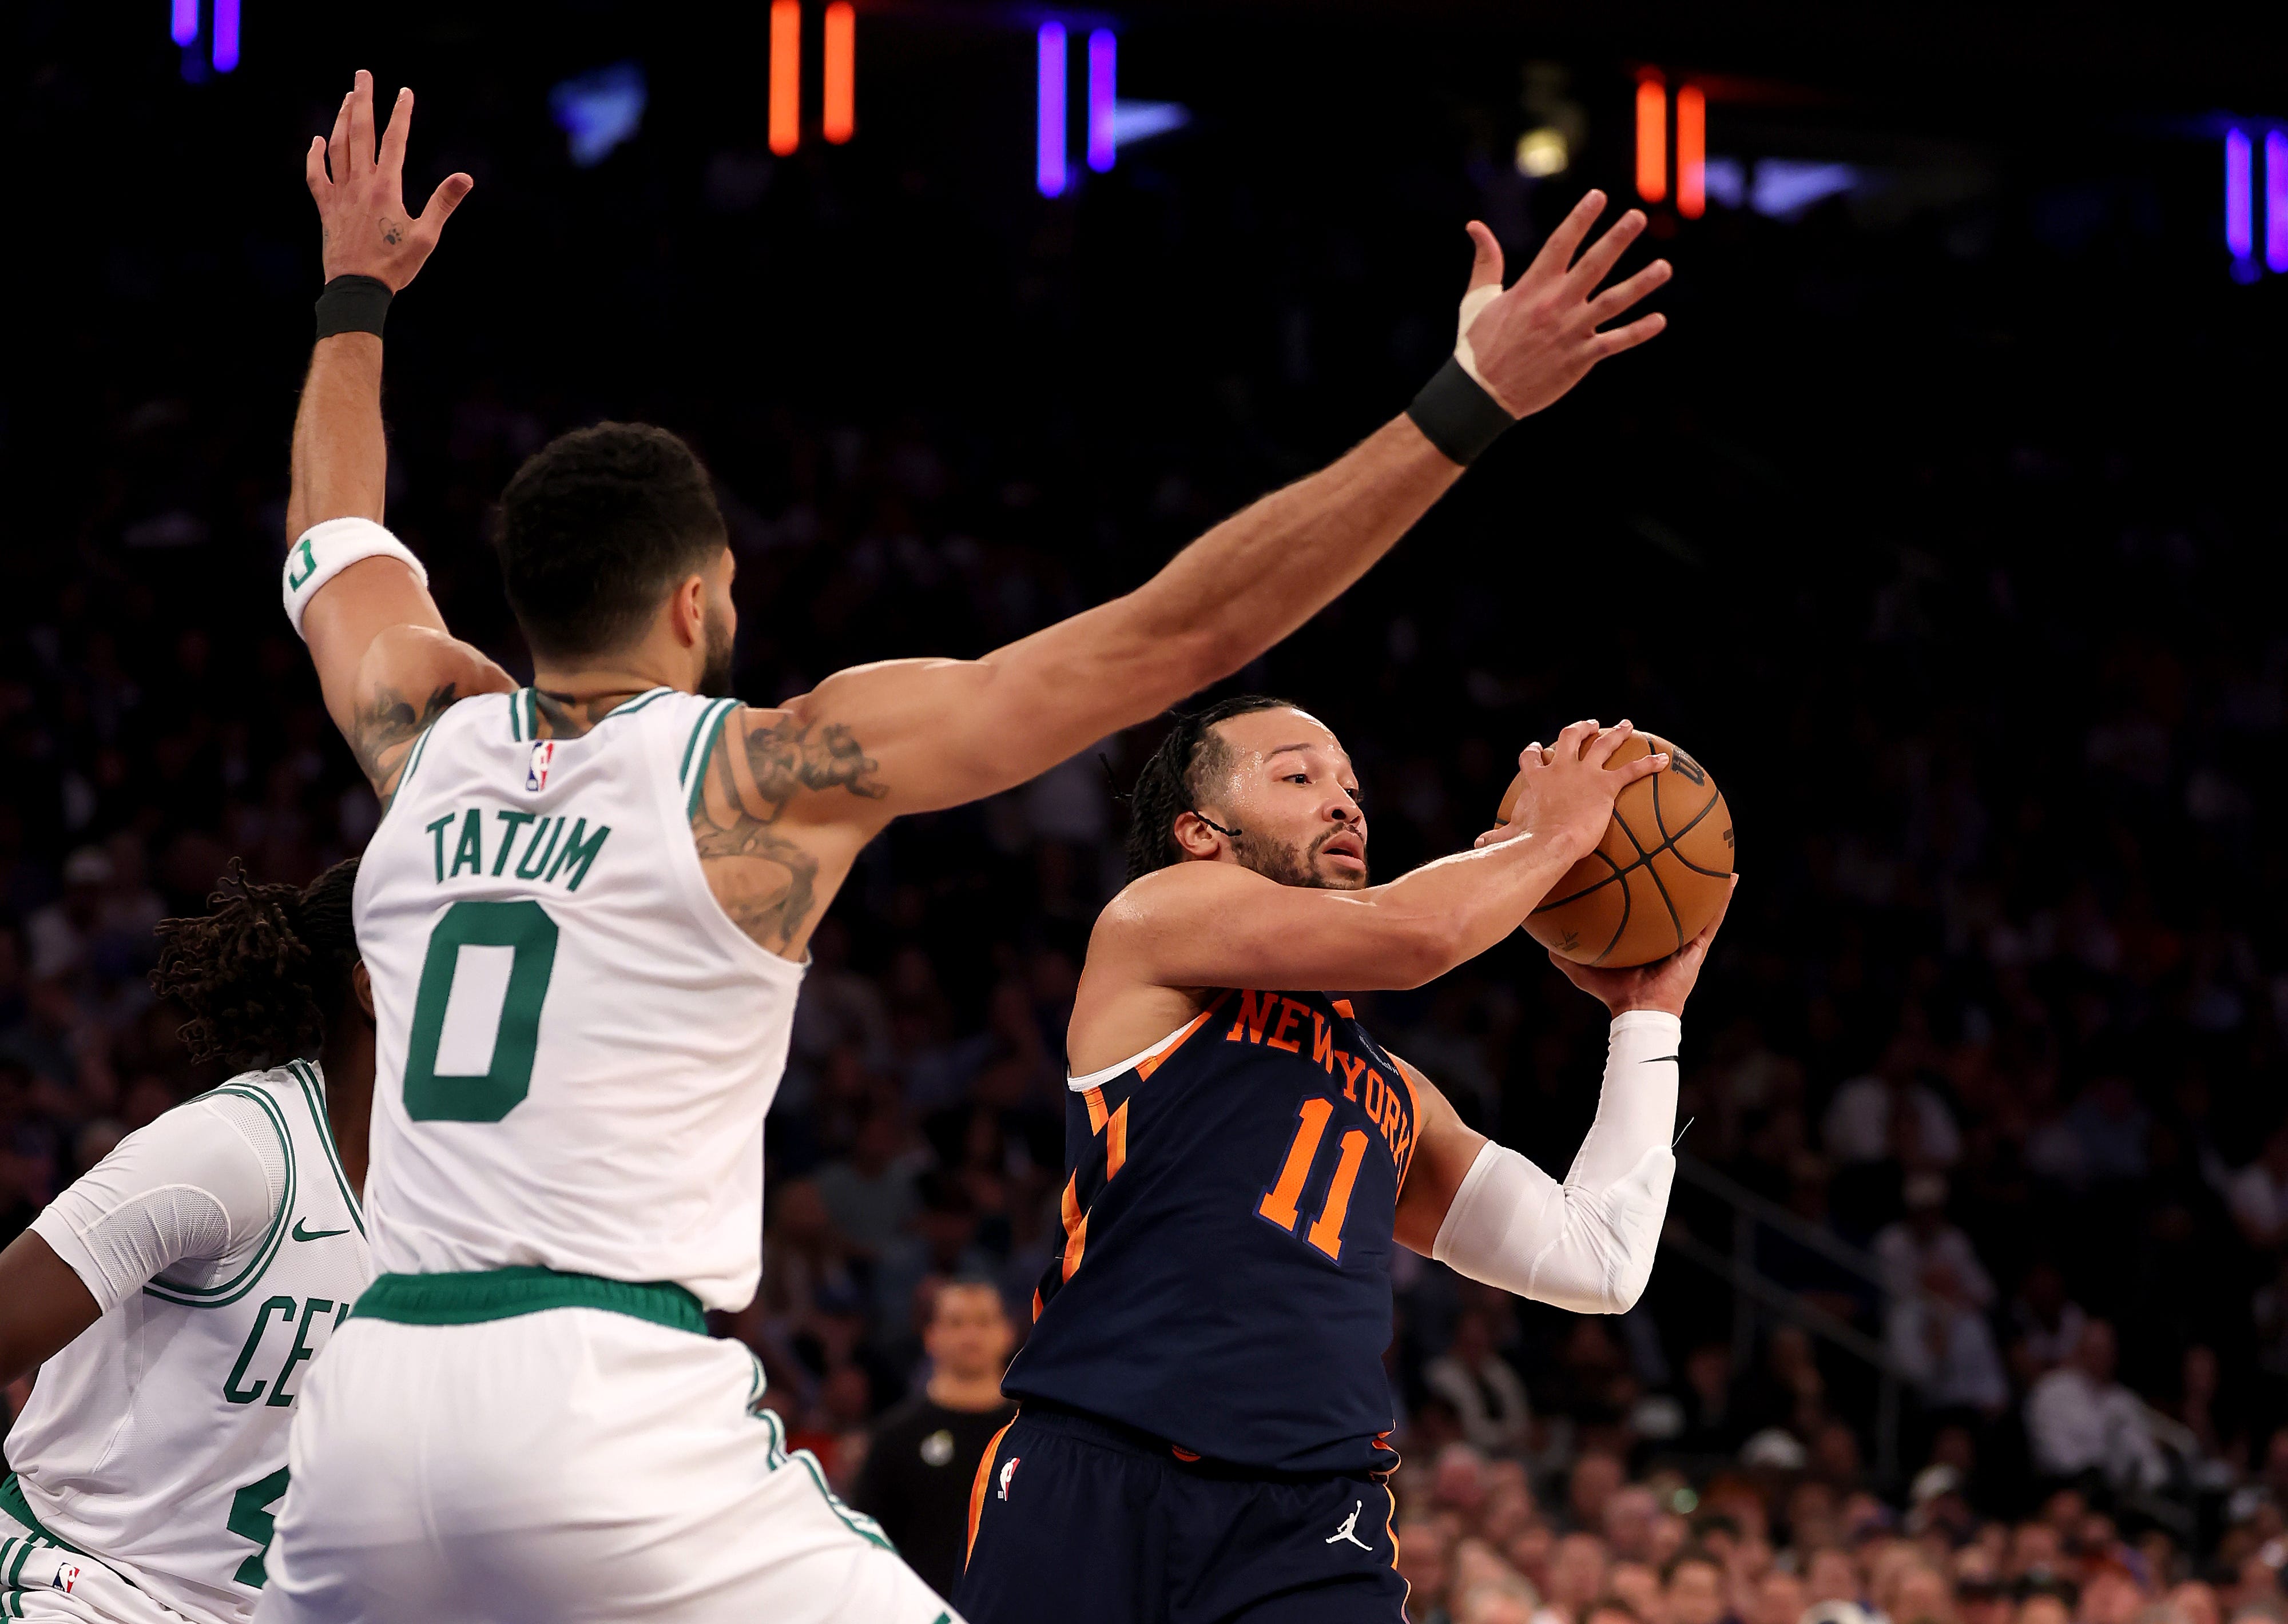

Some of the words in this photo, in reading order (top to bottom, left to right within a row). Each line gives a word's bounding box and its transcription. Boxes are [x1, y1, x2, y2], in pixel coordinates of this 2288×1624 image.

[425, 808, 611, 892] TATUM
[402, 899, 559, 1123] 0
[1226, 989, 1334, 1074] NEW
[1334, 1050, 1410, 1187] YORK
[1253, 1094, 1371, 1266] 11
[223, 1295, 350, 1407] CE
